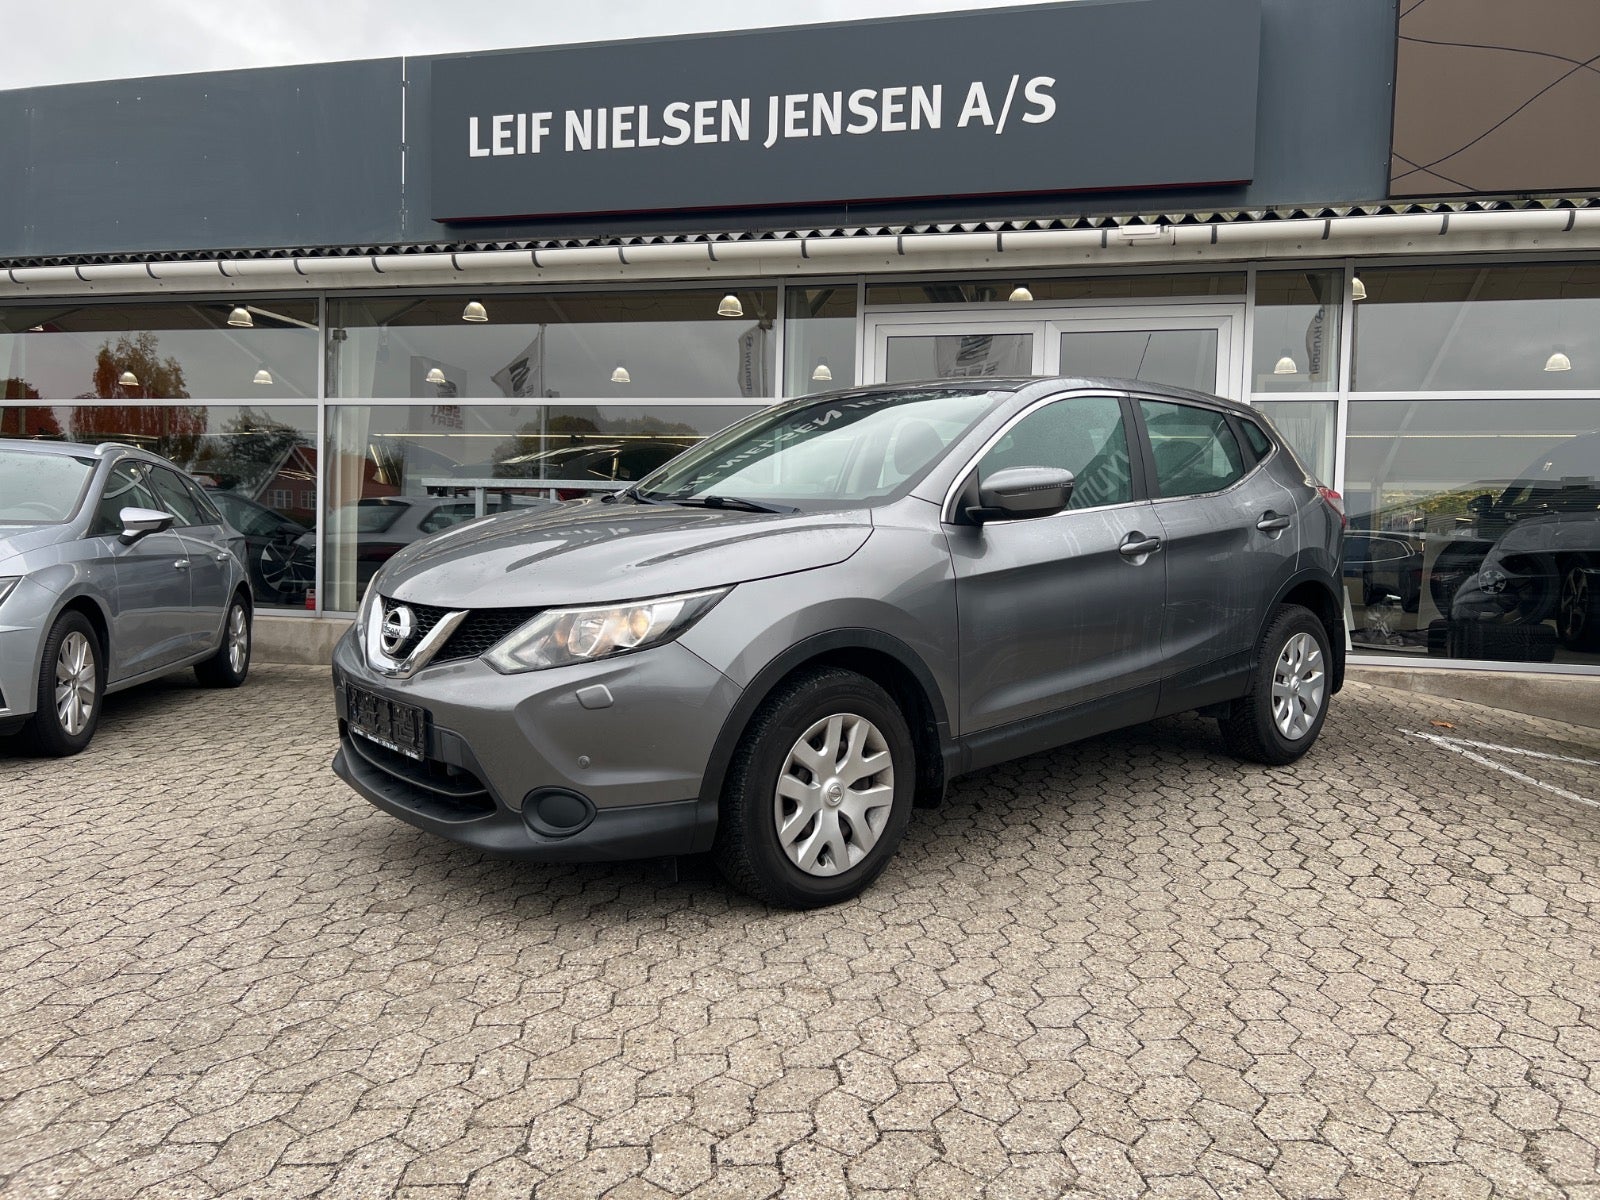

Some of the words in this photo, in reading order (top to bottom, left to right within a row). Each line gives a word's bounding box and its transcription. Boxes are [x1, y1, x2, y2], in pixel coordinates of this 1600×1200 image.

[469, 111, 553, 158] LEIF
[564, 98, 751, 152] NIELSEN
[763, 83, 943, 149] JENSEN
[956, 74, 1057, 135] A/S
